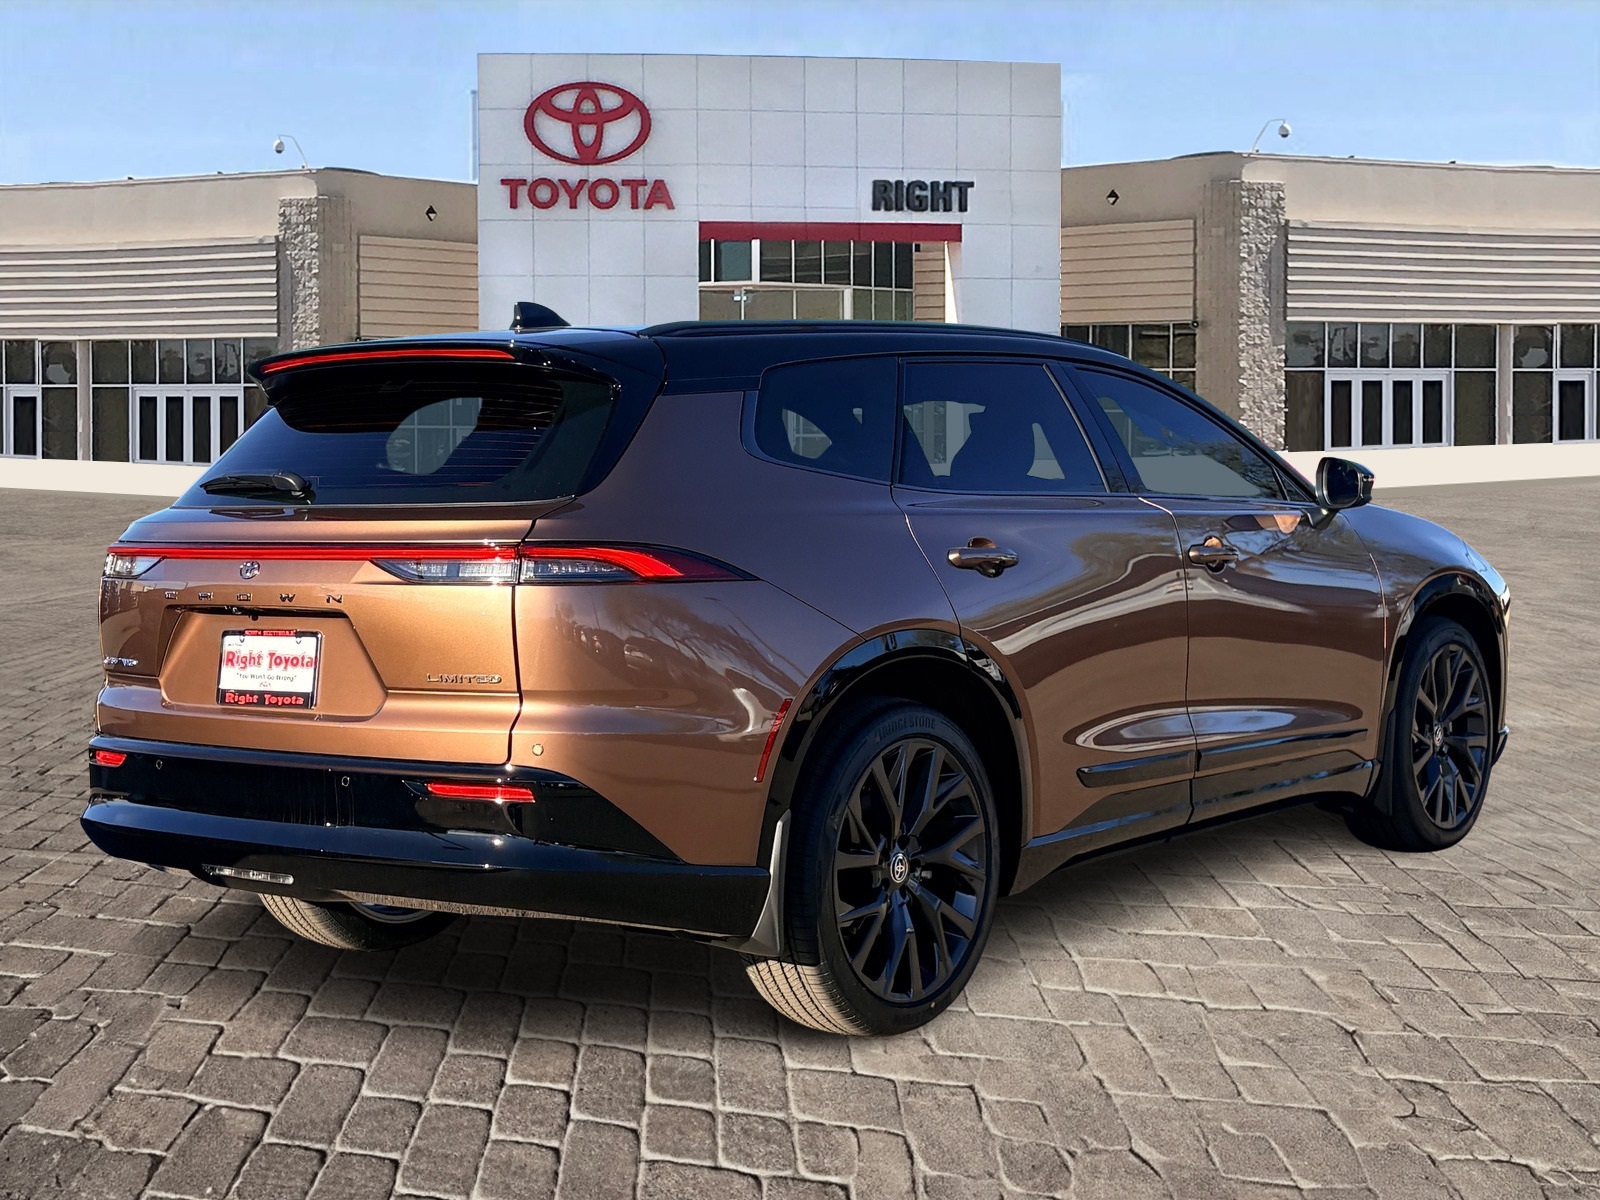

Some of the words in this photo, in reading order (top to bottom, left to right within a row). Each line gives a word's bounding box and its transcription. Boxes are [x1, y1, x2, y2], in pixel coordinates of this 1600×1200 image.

[500, 178, 675, 211] TOYOTA
[871, 179, 975, 212] RIGHT
[165, 591, 343, 604] CROWN
[225, 650, 262, 670] Right
[268, 651, 315, 670] Toyota
[427, 673, 502, 684] LIMITED
[225, 692, 258, 704] Right
[264, 694, 304, 705] Toyota
[875, 717, 936, 741] BRIDGESTONE
